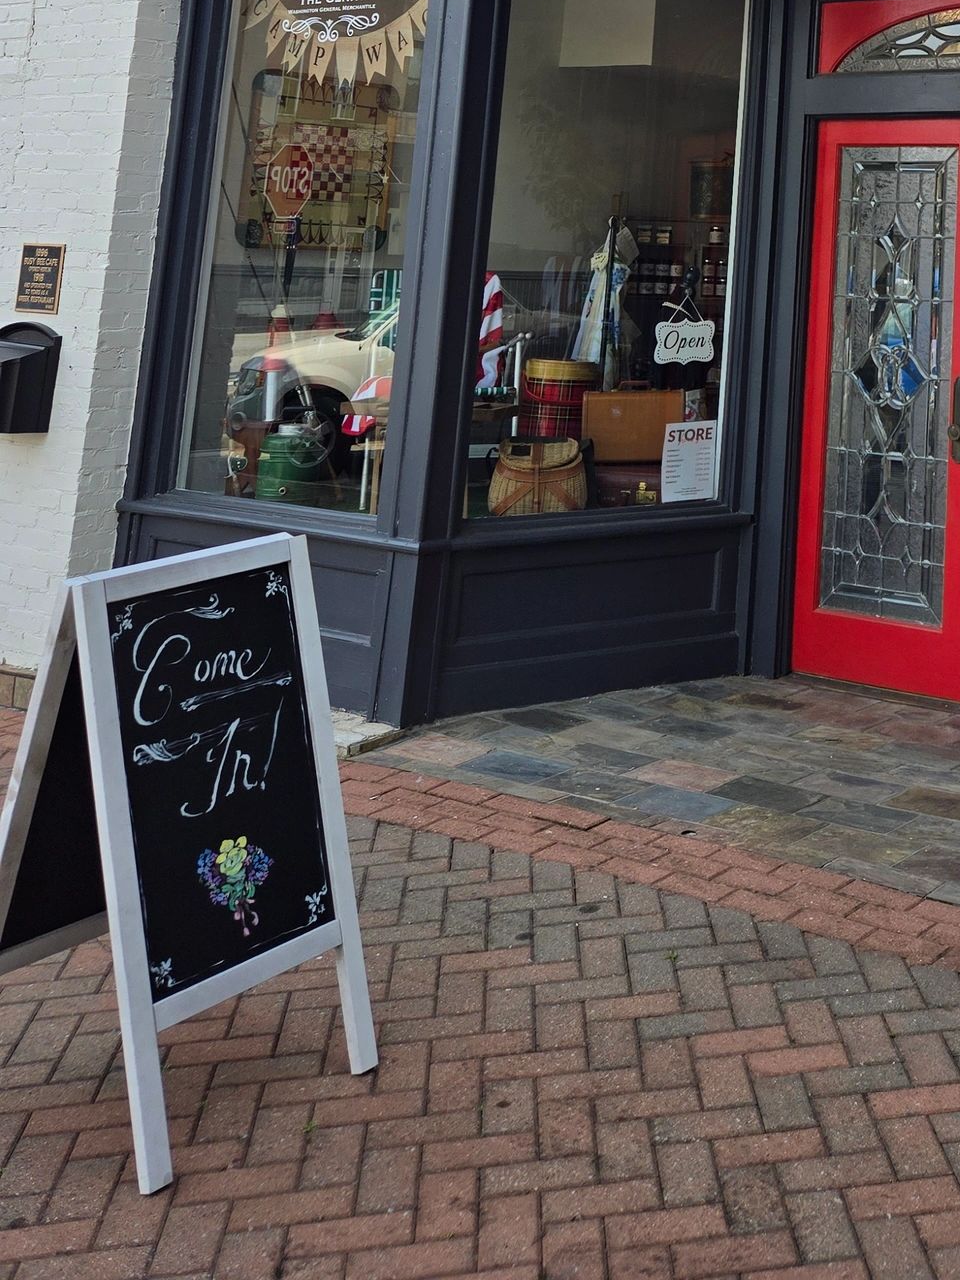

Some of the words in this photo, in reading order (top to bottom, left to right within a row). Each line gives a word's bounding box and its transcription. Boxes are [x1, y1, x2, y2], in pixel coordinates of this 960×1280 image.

[663, 330, 706, 355] Open
[667, 427, 713, 443] STORE
[132, 605, 272, 726] Come
[180, 697, 284, 817] In!
